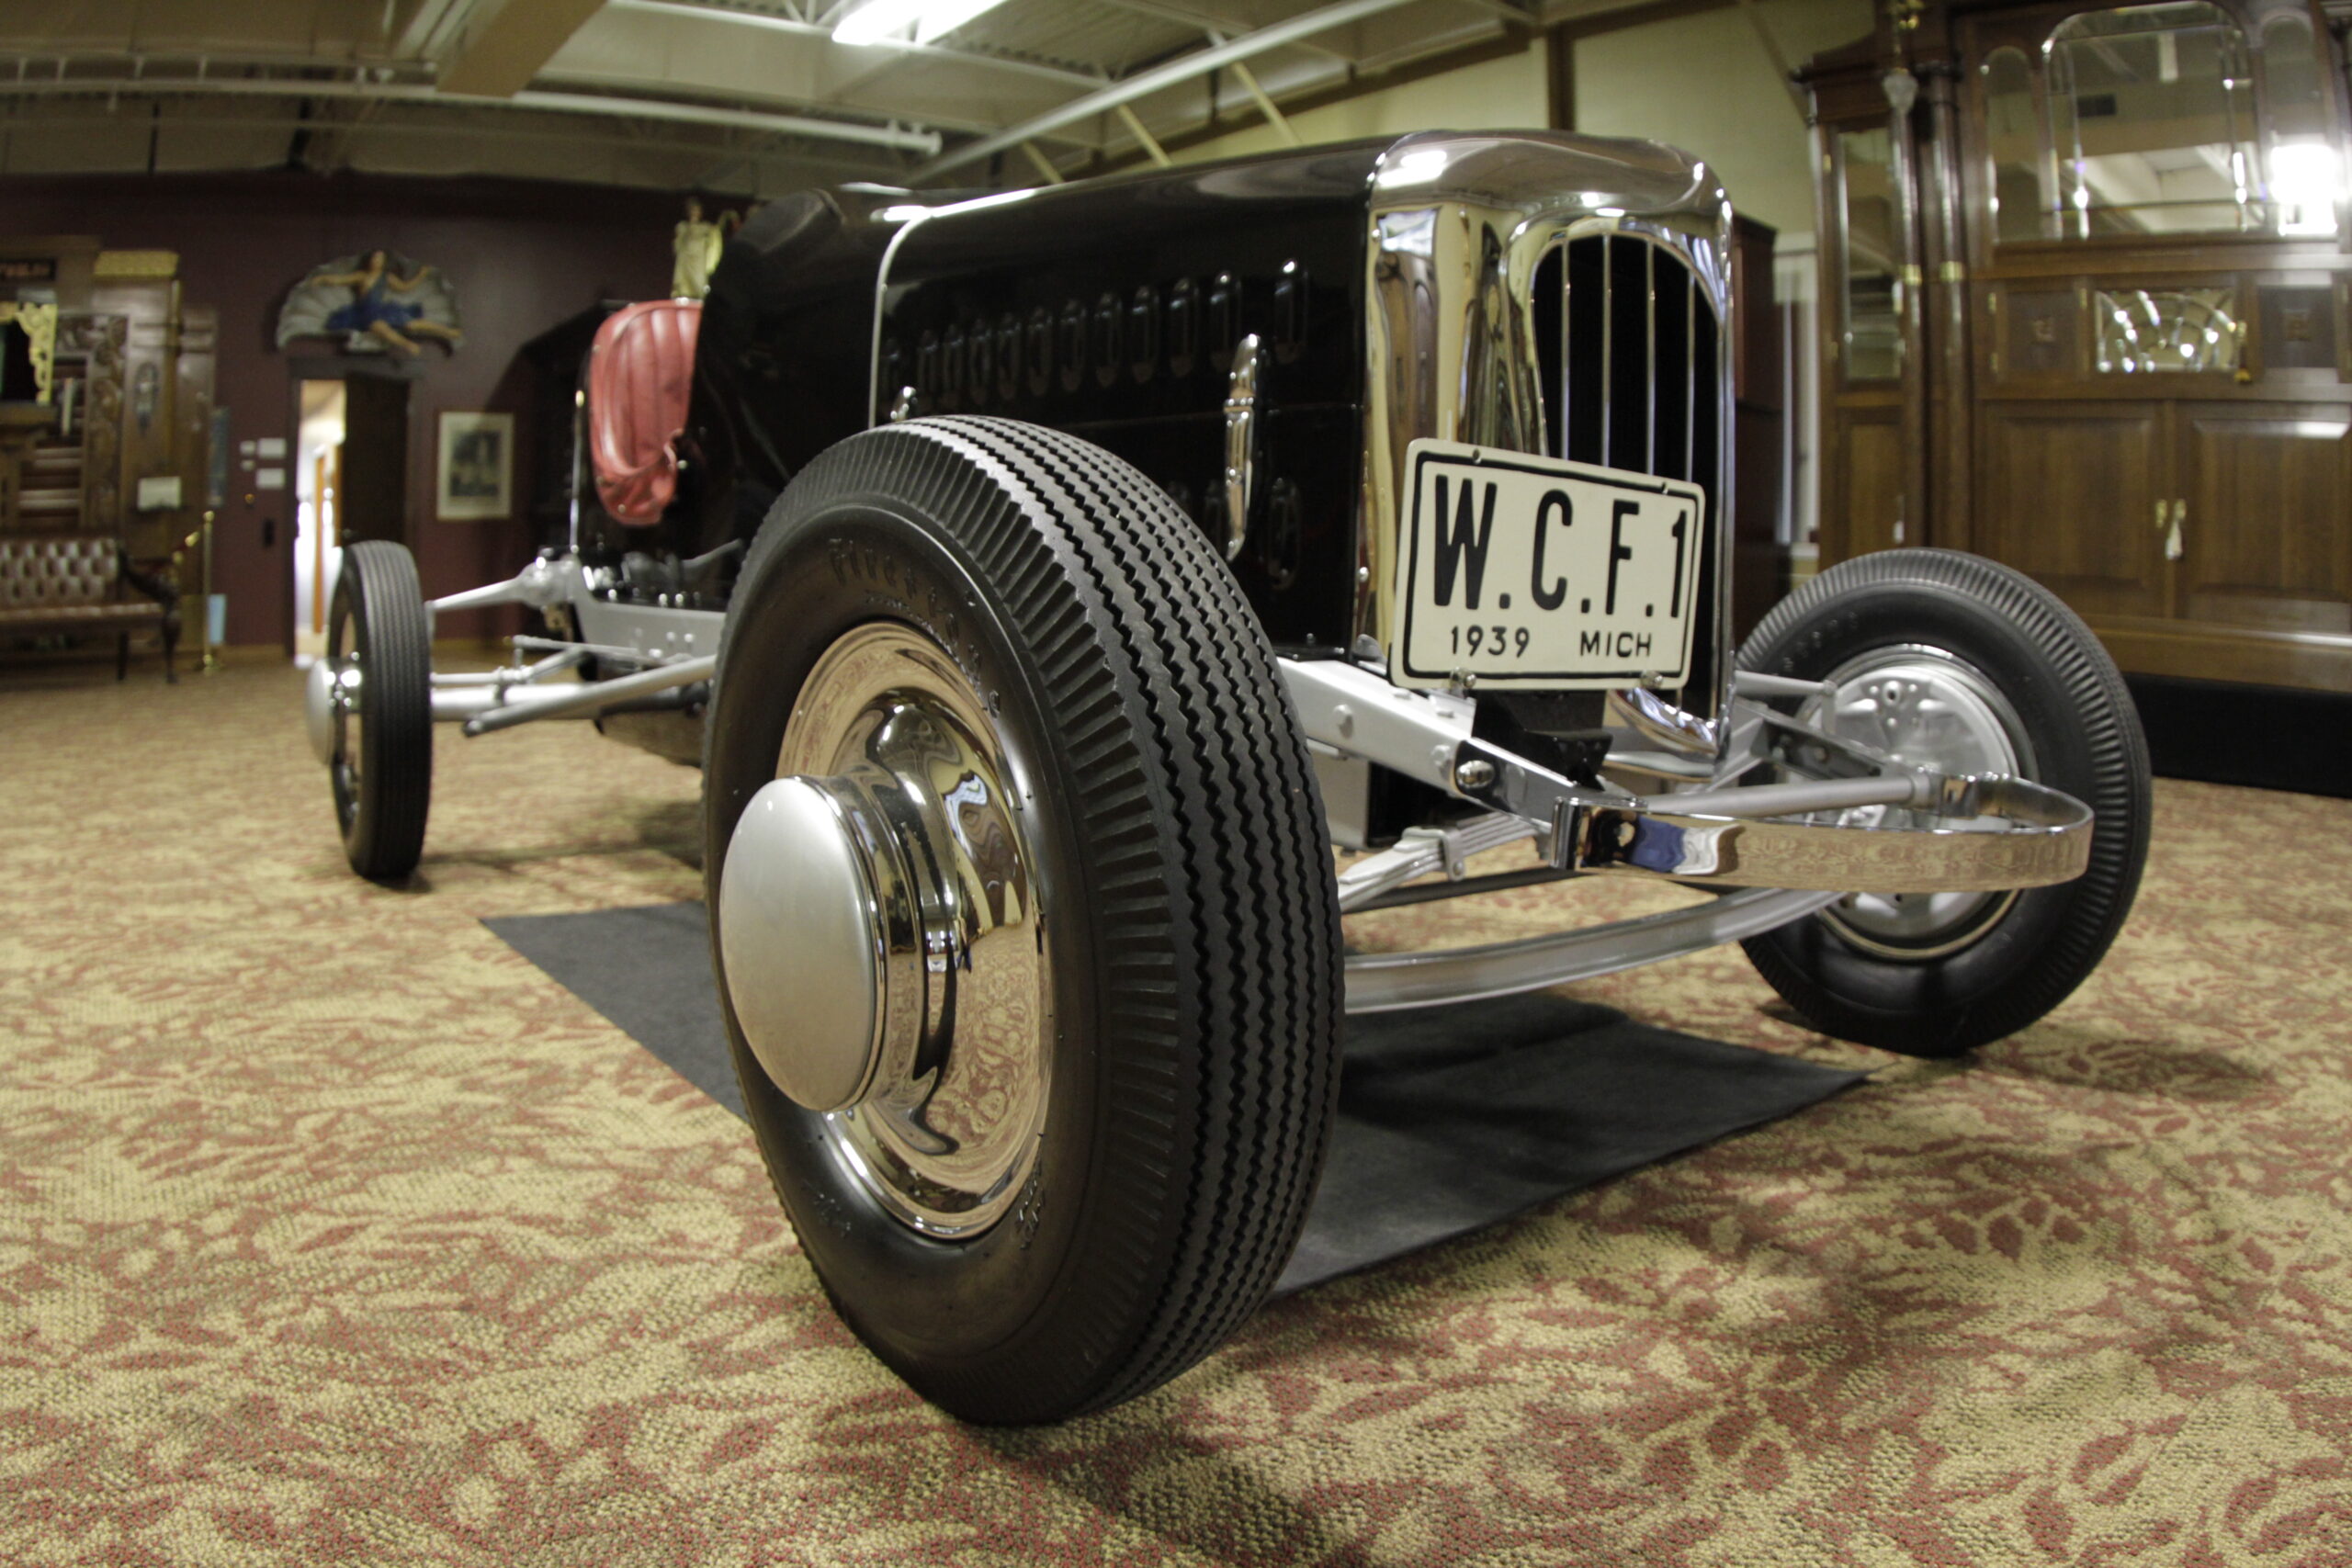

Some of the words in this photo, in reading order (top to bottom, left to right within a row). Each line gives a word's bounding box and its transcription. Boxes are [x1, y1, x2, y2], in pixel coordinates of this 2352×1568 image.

[1433, 474, 1688, 618] W.C.F.1
[1452, 625, 1531, 659] 1939
[1579, 630, 1653, 659] MICH
